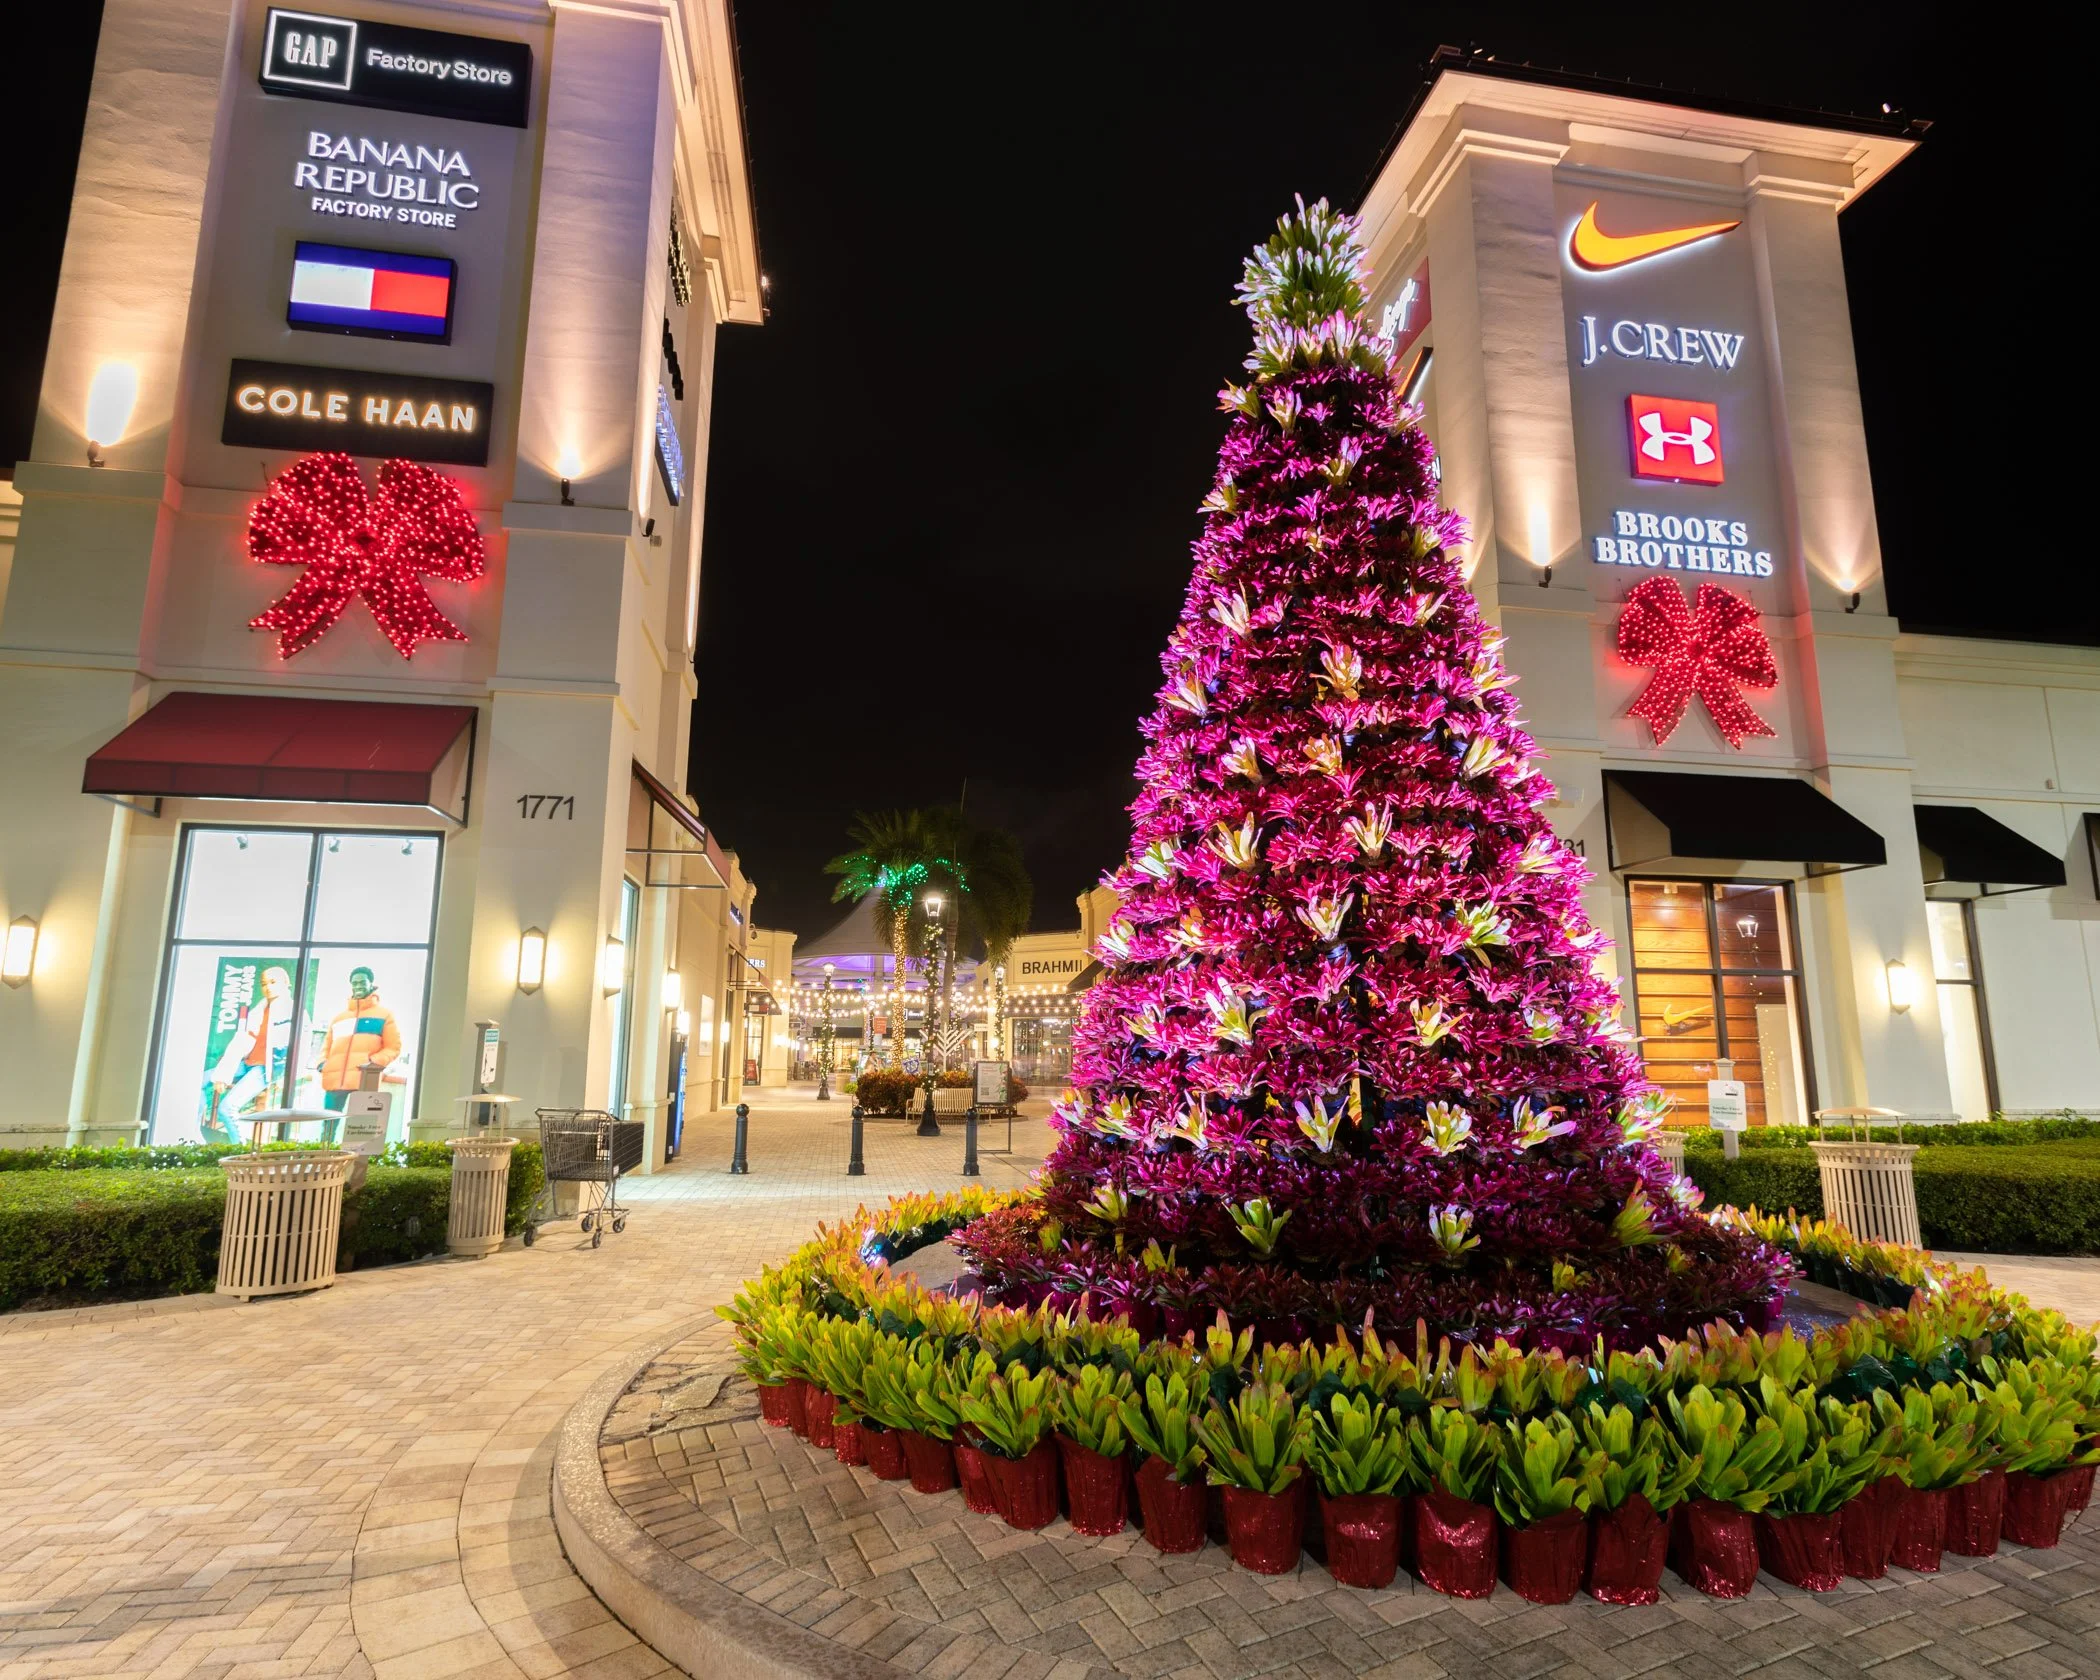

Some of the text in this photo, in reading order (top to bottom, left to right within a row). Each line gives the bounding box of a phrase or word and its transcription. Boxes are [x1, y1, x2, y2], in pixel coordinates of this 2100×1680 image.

[283, 30, 338, 69] GAP
[367, 48, 512, 85] Factory Store
[308, 131, 472, 177] BANANA
[294, 162, 480, 210] REPUBLIC
[311, 197, 457, 229] FACTORY STORE
[1580, 315, 1744, 371] J.CREW
[237, 385, 476, 433] COLE HAAN
[1614, 510, 1749, 547] BROOKS
[1594, 537, 1774, 578] BROTHERS
[517, 794, 575, 820] 1771
[216, 964, 243, 1034] TOMMY
[240, 965, 257, 1007] JEANS
